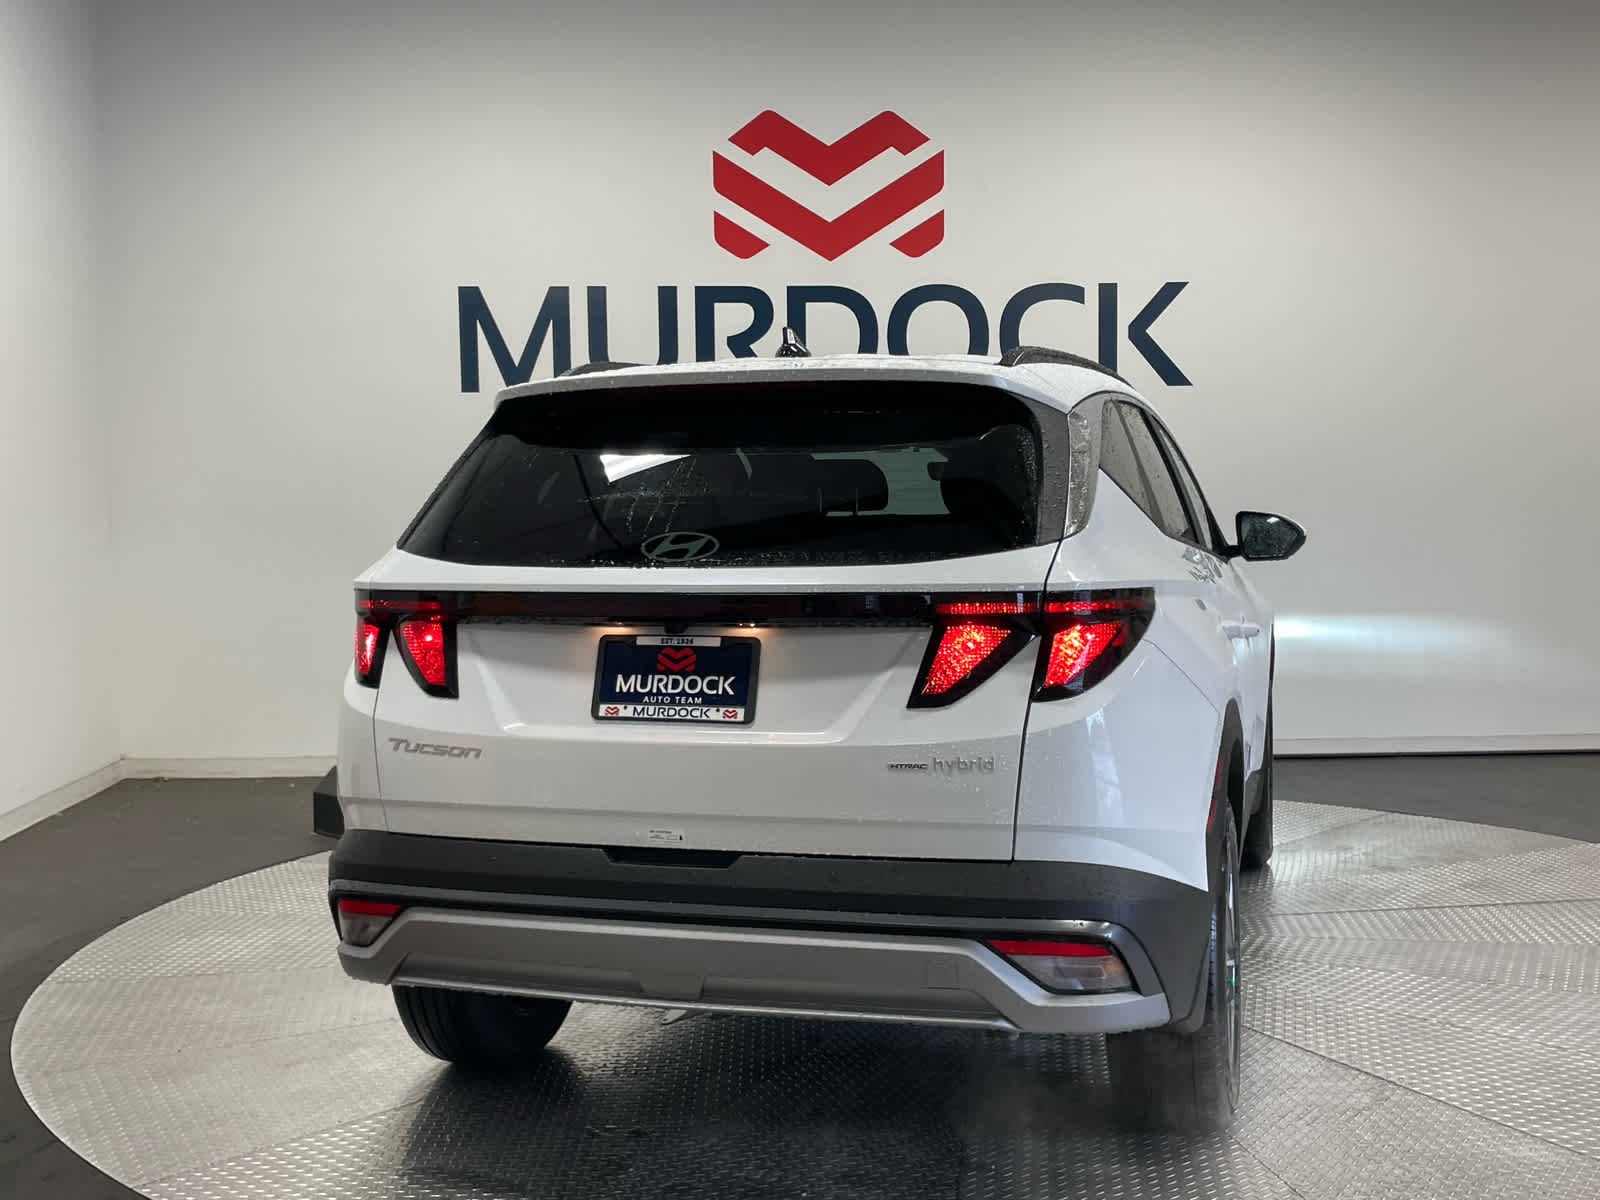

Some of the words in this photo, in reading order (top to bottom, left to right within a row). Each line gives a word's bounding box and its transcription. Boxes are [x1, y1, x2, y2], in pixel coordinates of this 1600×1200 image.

[458, 281, 1194, 392] MURDOCK
[615, 674, 736, 695] MURDOCK
[642, 695, 671, 704] AUTO
[675, 696, 702, 704] TEAM
[632, 706, 711, 719] MURDOCK
[933, 757, 994, 778] hybrid
